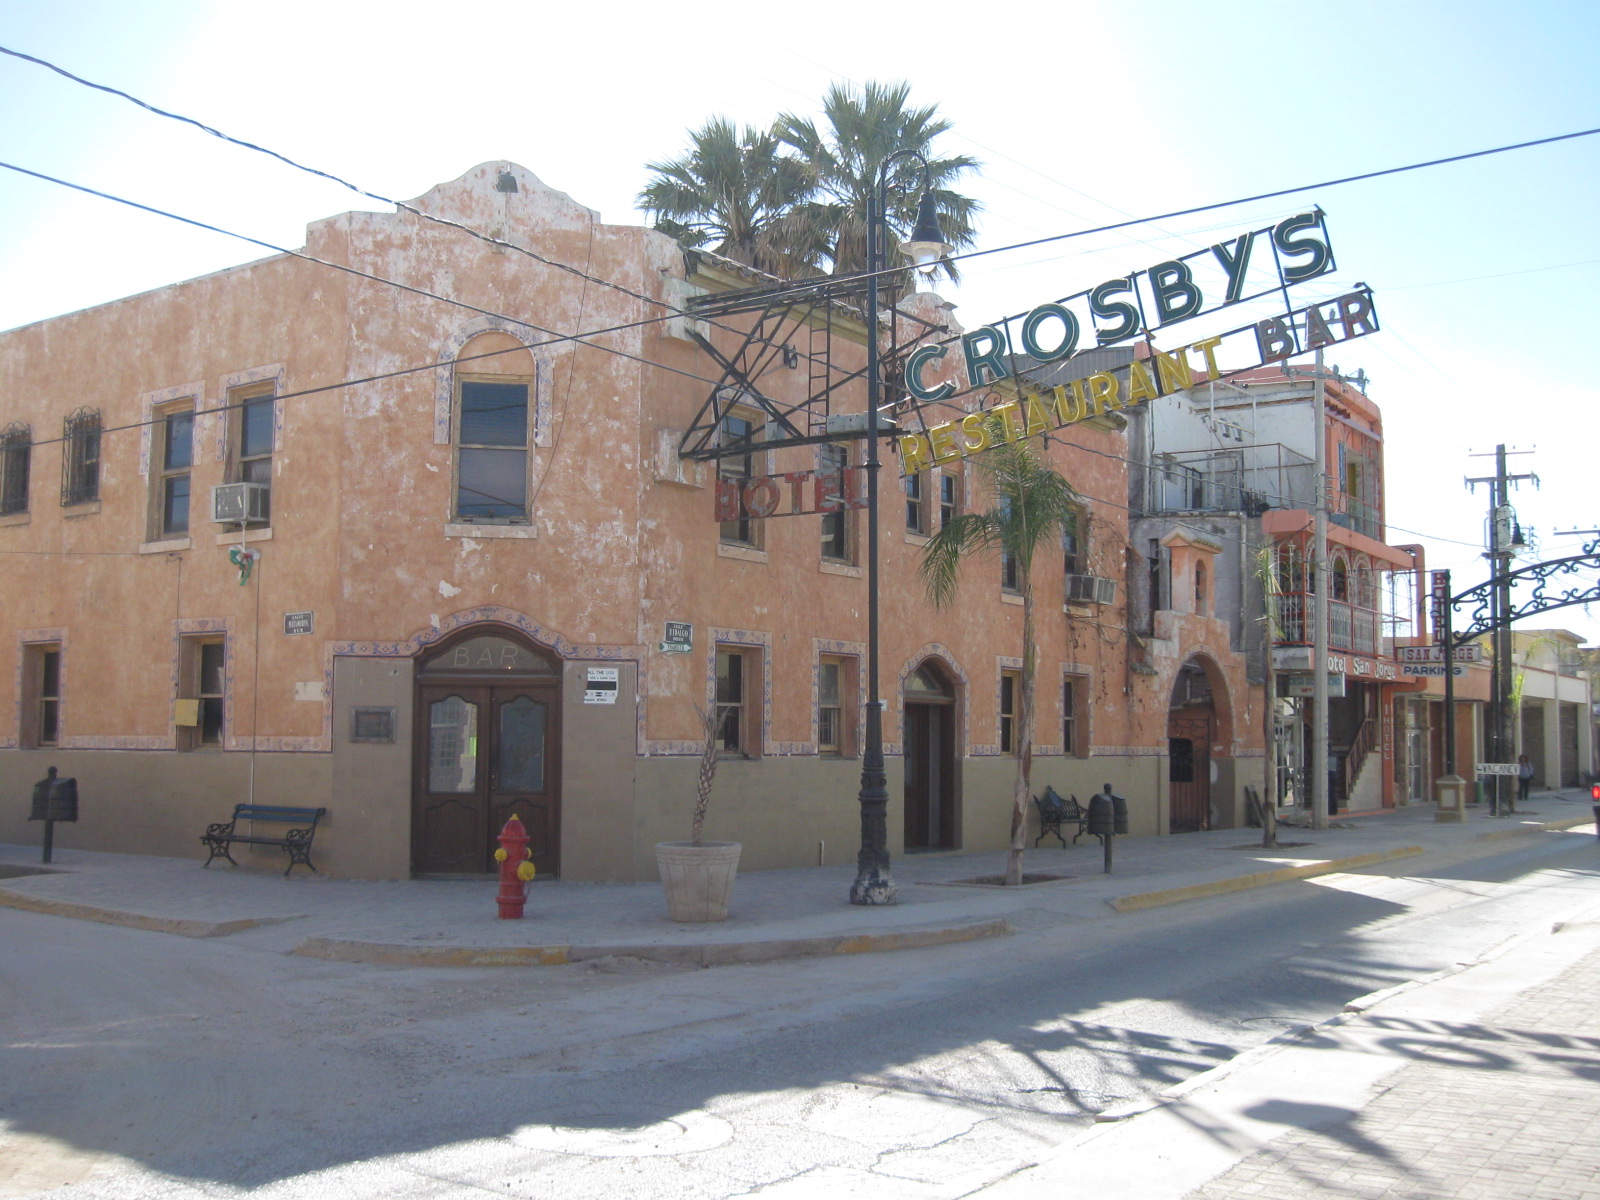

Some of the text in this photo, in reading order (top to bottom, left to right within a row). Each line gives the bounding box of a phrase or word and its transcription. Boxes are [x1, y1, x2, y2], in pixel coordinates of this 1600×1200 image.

[899, 291, 1375, 475] RESTAURANT BAR
[715, 466, 869, 522] HOTEL
[669, 628, 689, 637] HIDALGO
[453, 645, 519, 667] BAR
[1407, 648, 1430, 660] SAN
[1353, 657, 1370, 675] San
[1374, 661, 1396, 680] Jorge
